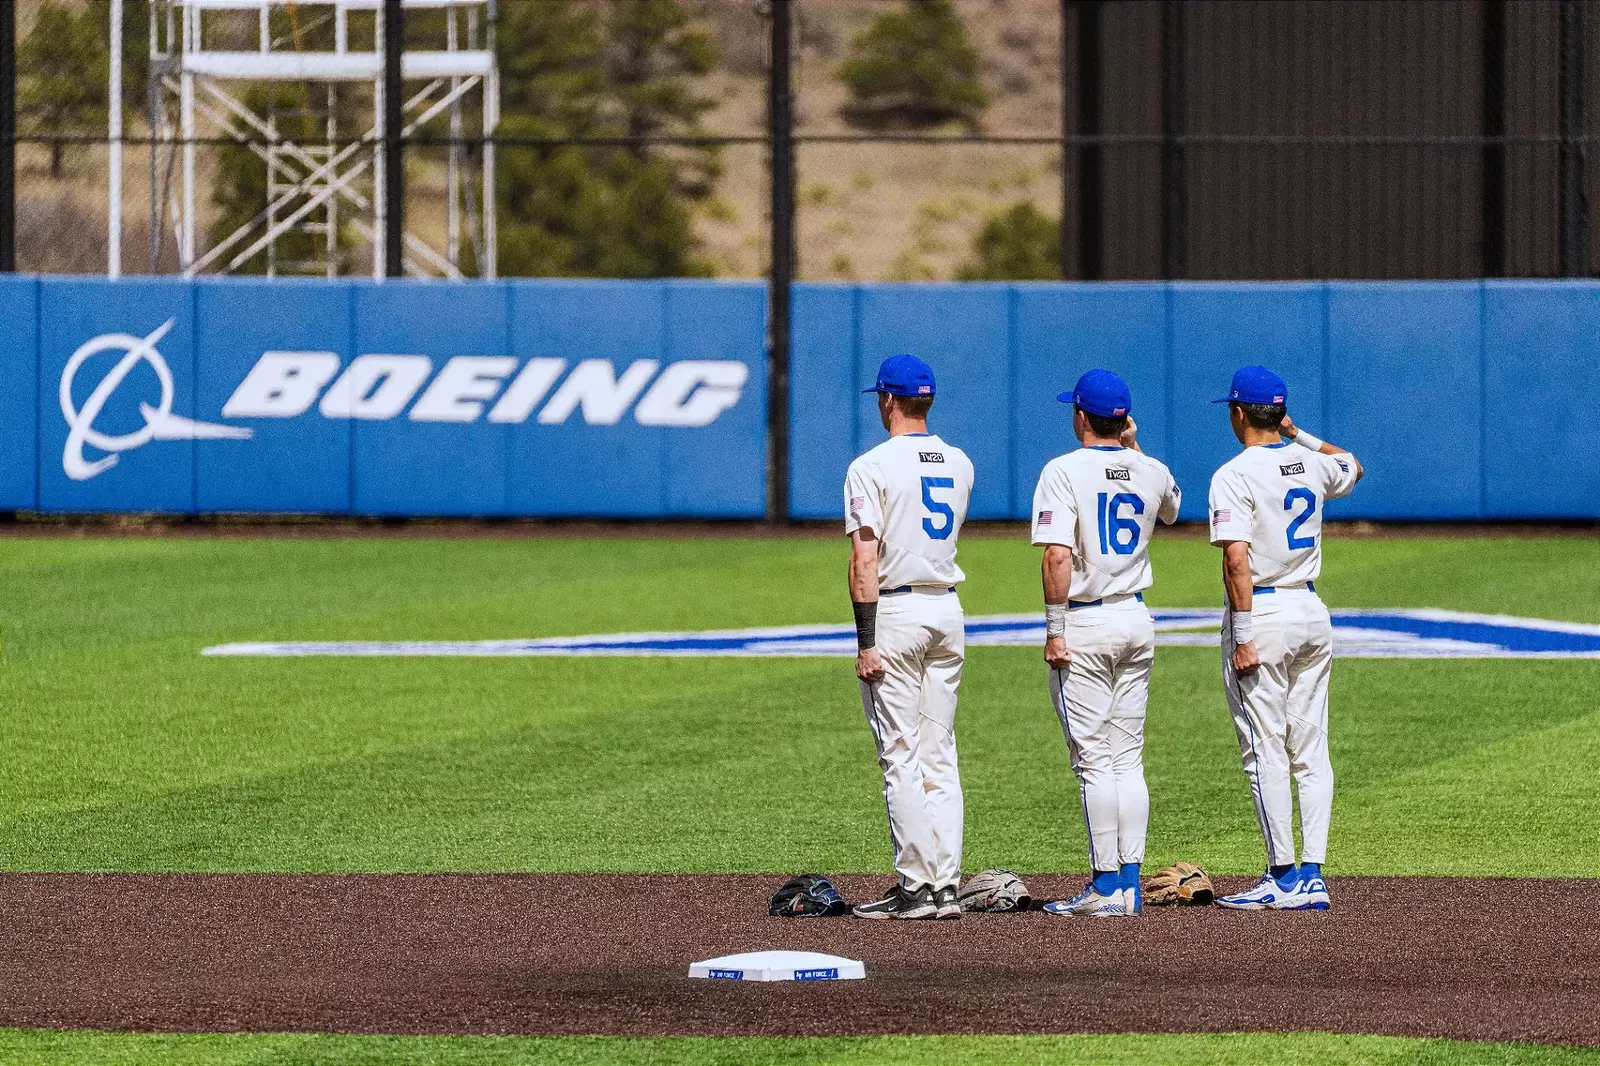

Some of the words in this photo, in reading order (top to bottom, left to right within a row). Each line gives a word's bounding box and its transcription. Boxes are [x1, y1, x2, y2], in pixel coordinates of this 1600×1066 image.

[223, 351, 748, 427] BOEING
[921, 453, 943, 462] TW20
[1107, 469, 1129, 480] TW20
[1281, 463, 1304, 475] TW20
[920, 476, 955, 540] 5
[1097, 492, 1145, 555] 16
[1283, 487, 1317, 550] 2
